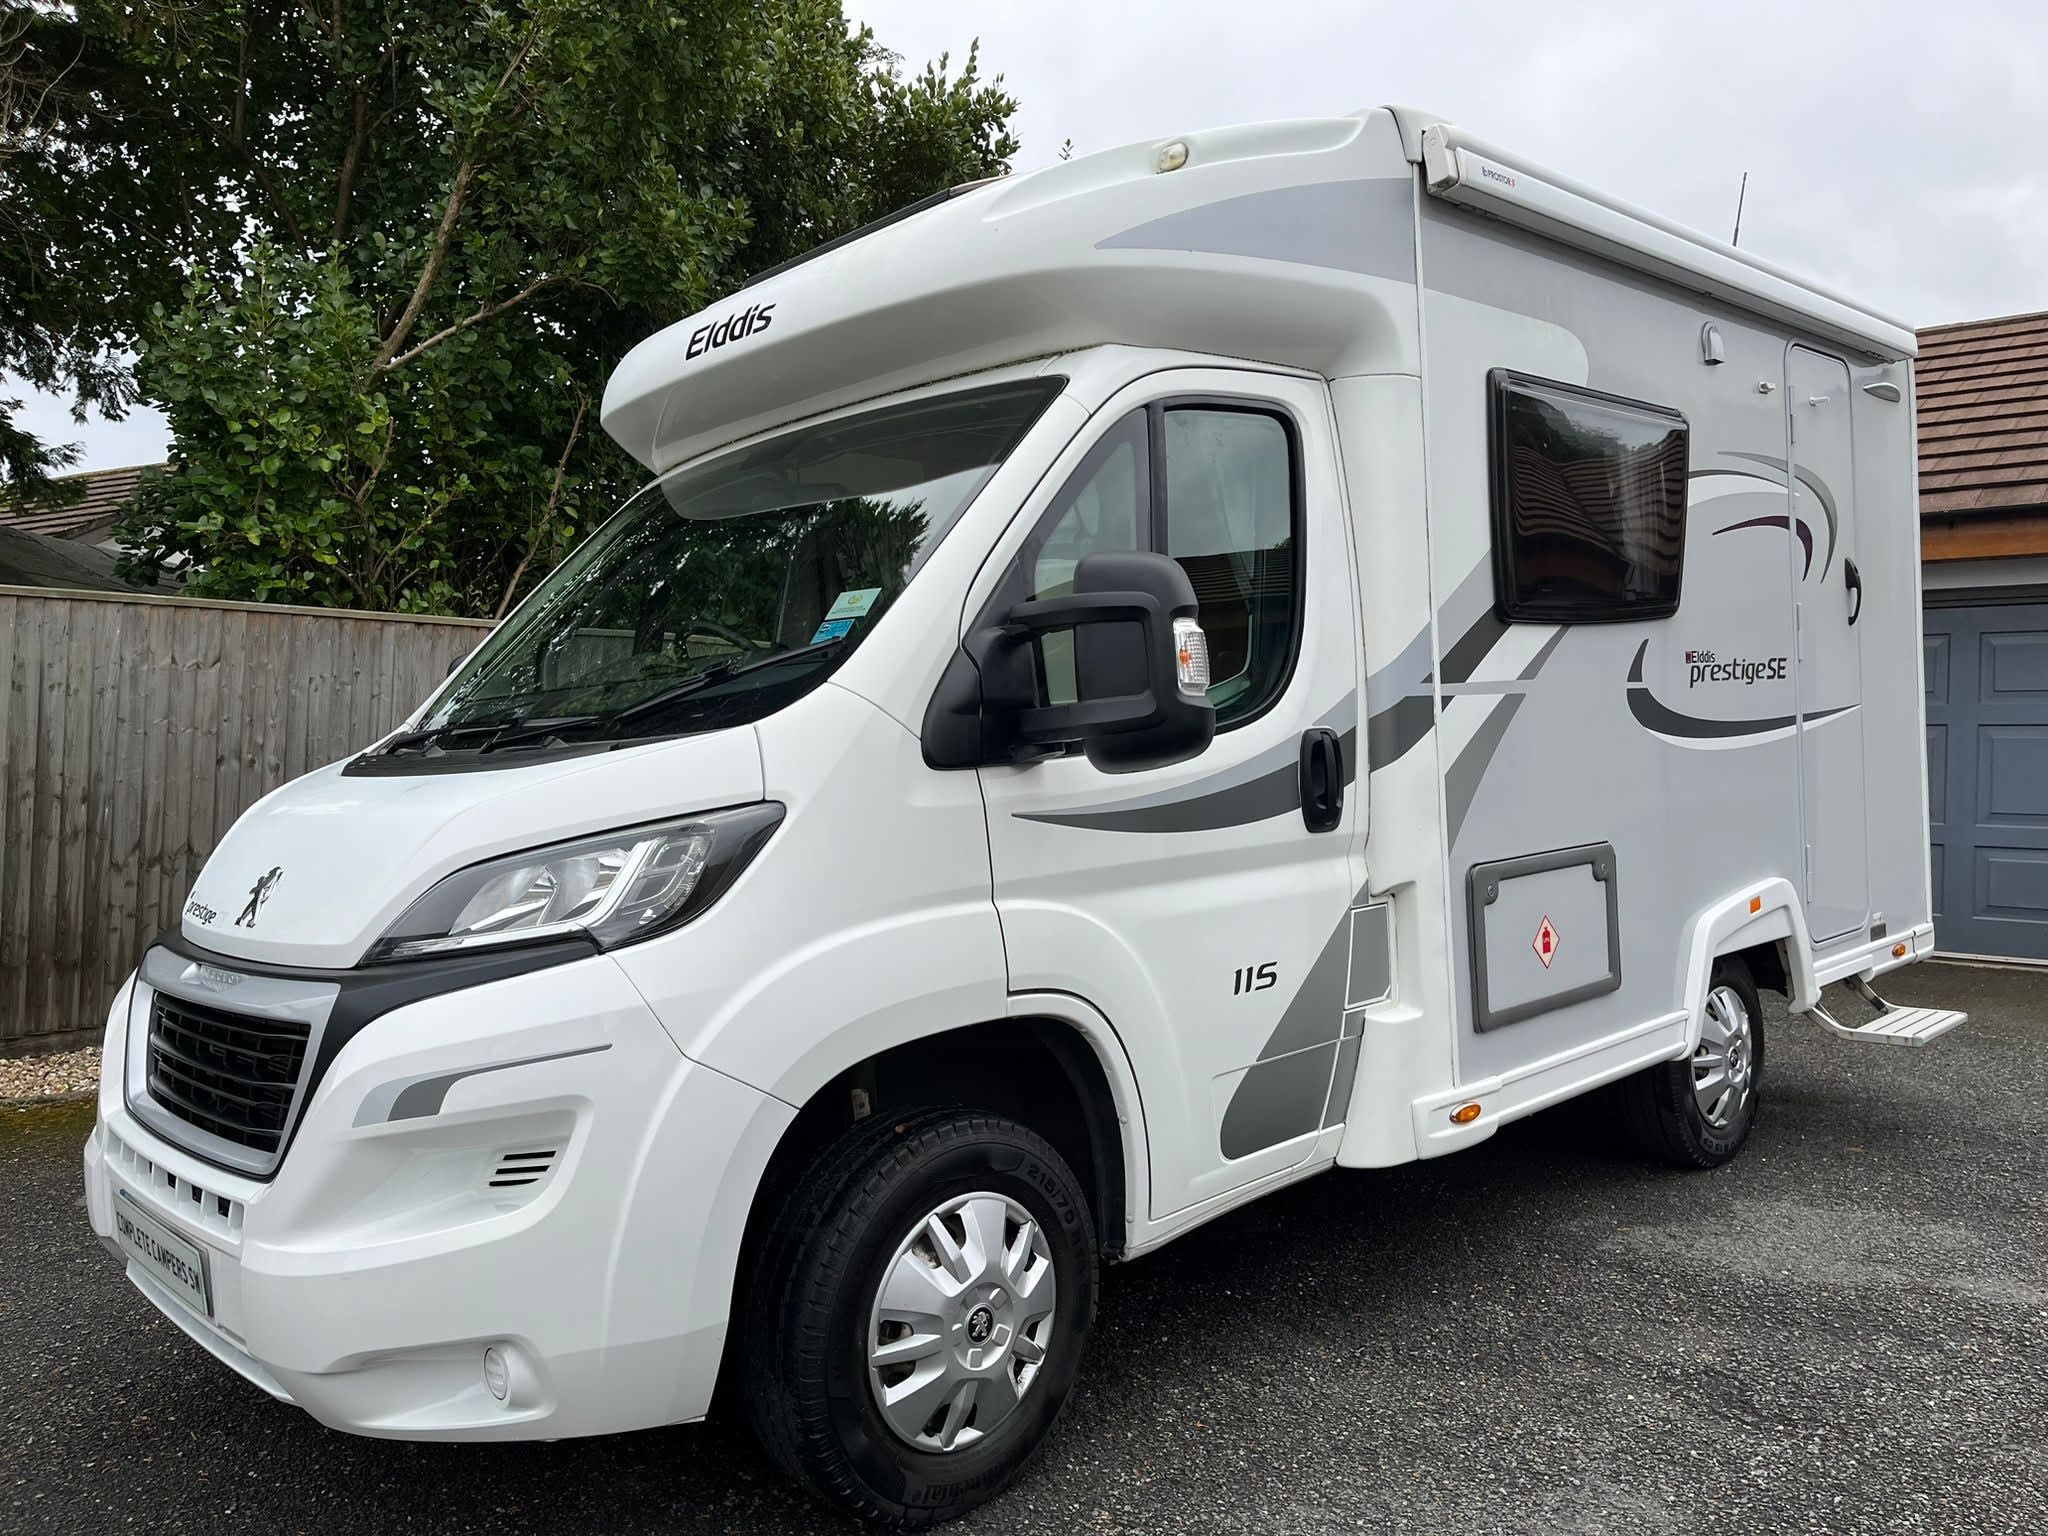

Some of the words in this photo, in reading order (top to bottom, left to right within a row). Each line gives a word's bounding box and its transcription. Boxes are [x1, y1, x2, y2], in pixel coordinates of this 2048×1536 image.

[685, 303, 777, 360] Elddis
[1691, 650, 1716, 663] Elddis
[1689, 657, 1788, 688] prestigeSE
[185, 901, 217, 926] prestige
[151, 1239, 188, 1284] CAMPERS
